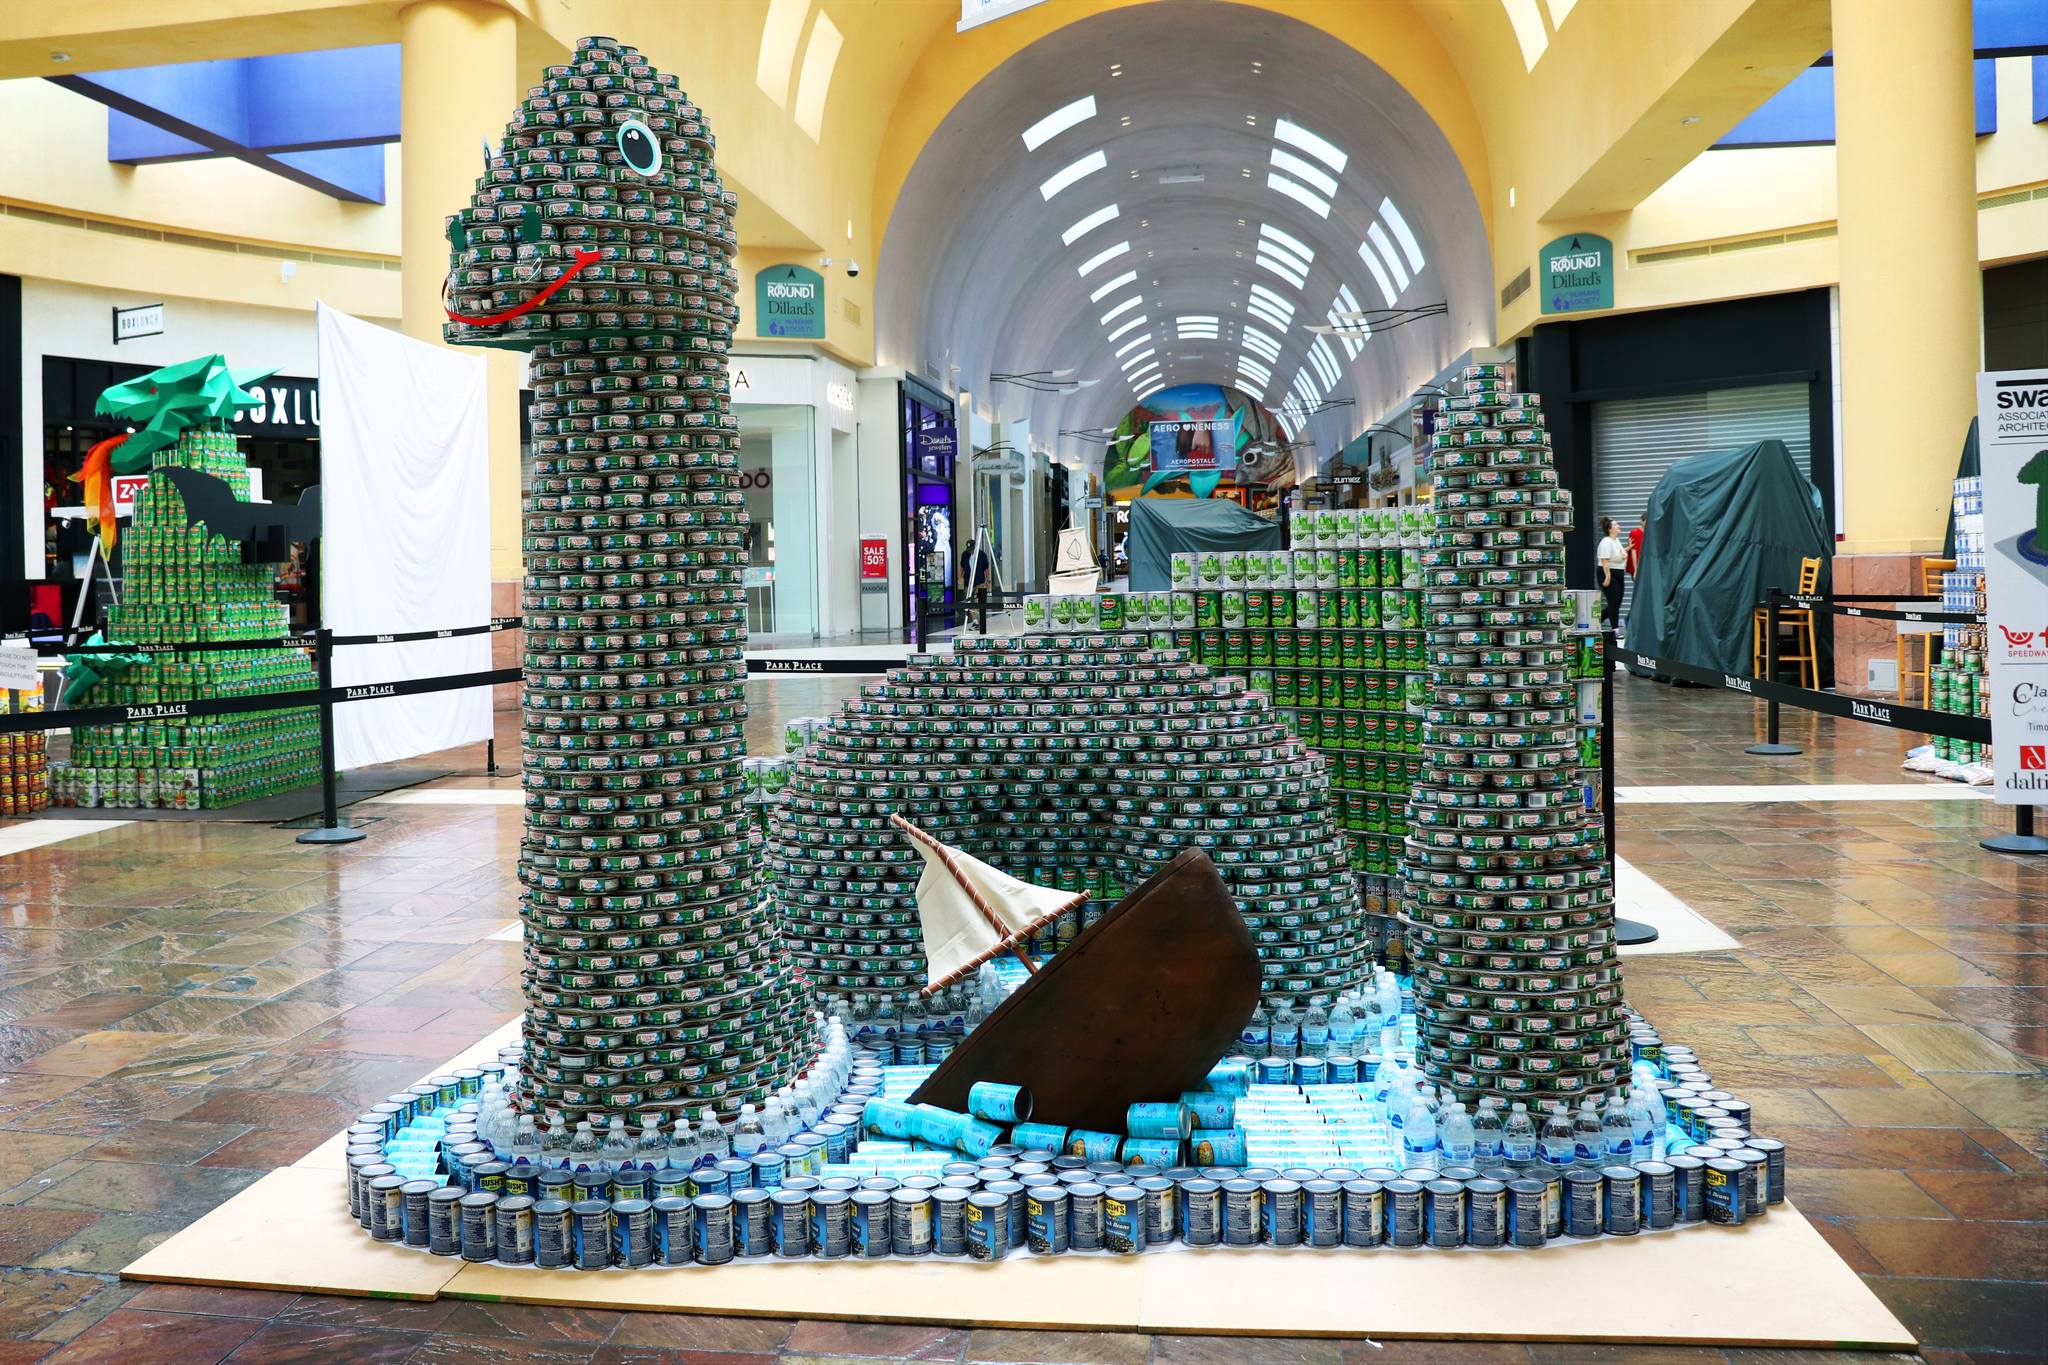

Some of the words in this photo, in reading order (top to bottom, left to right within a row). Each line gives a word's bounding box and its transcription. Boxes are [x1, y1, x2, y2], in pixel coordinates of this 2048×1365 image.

[1550, 251, 1601, 273] ROUND1
[1552, 272, 1601, 289] Dillard's
[767, 283, 814, 299] ROUND1
[768, 300, 815, 316] Dillard's
[1153, 424, 1180, 433] AERO
[1998, 421, 2048, 432] ARCHITE
[1170, 457, 1216, 465] AEROPOSTALE
[863, 547, 885, 555] SALE
[282, 639, 300, 647] PARK
[300, 638, 316, 646] PLAC
[764, 660, 792, 671] PARK
[792, 660, 824, 671] PLACE
[1724, 674, 1738, 690] PARK
[1736, 677, 1752, 692] PLACE
[346, 687, 369, 699] PARK
[369, 684, 396, 697] PLACE
[126, 706, 156, 719] PARK
[156, 703, 189, 717] PLACE
[1852, 701, 1870, 719] PARK
[1869, 703, 1892, 723] PLACE
[481, 1177, 506, 1188] BUSH'S
